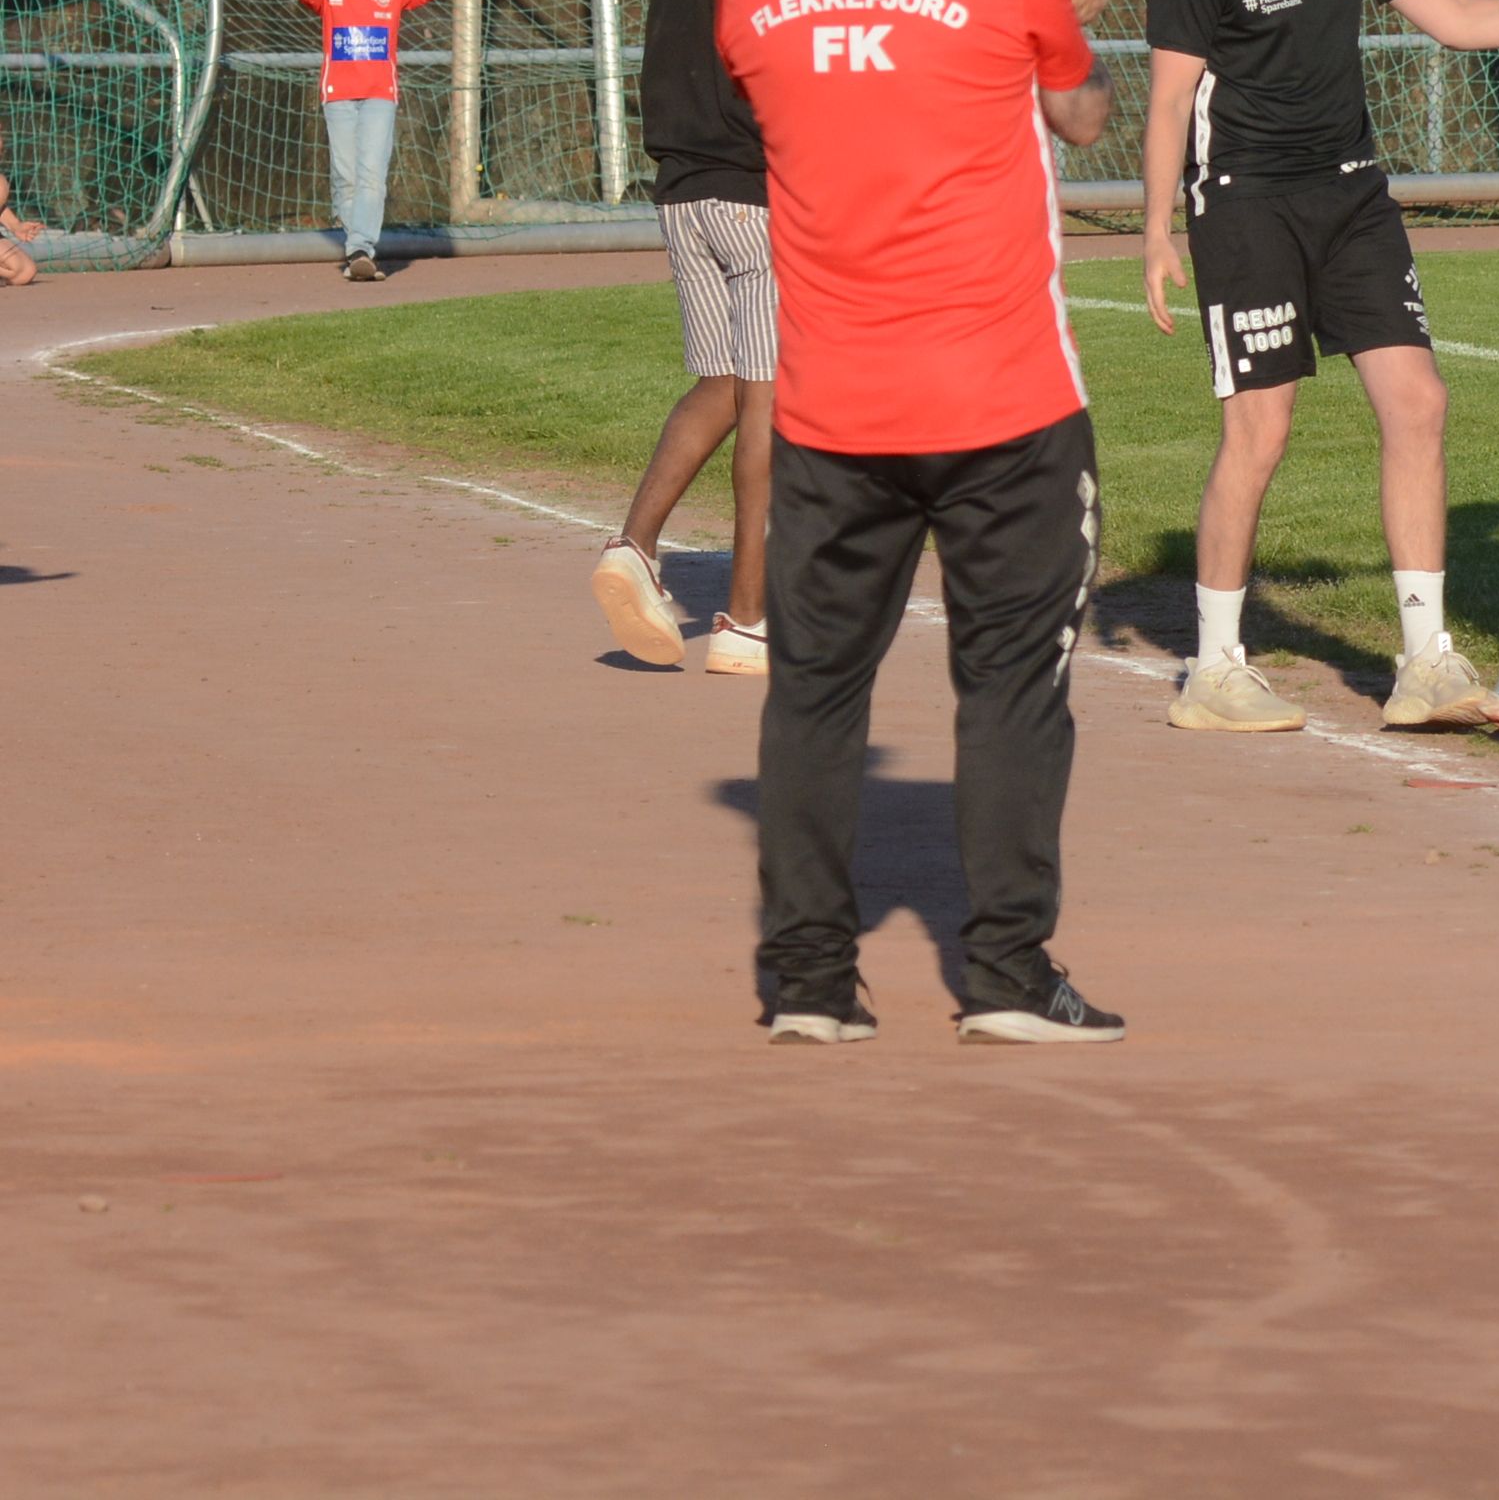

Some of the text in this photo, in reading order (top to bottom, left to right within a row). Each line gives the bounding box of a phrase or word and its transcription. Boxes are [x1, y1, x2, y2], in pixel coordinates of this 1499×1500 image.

[812, 23, 896, 74] FK
[1233, 301, 1297, 333] REMA
[1243, 325, 1293, 354] 1000
